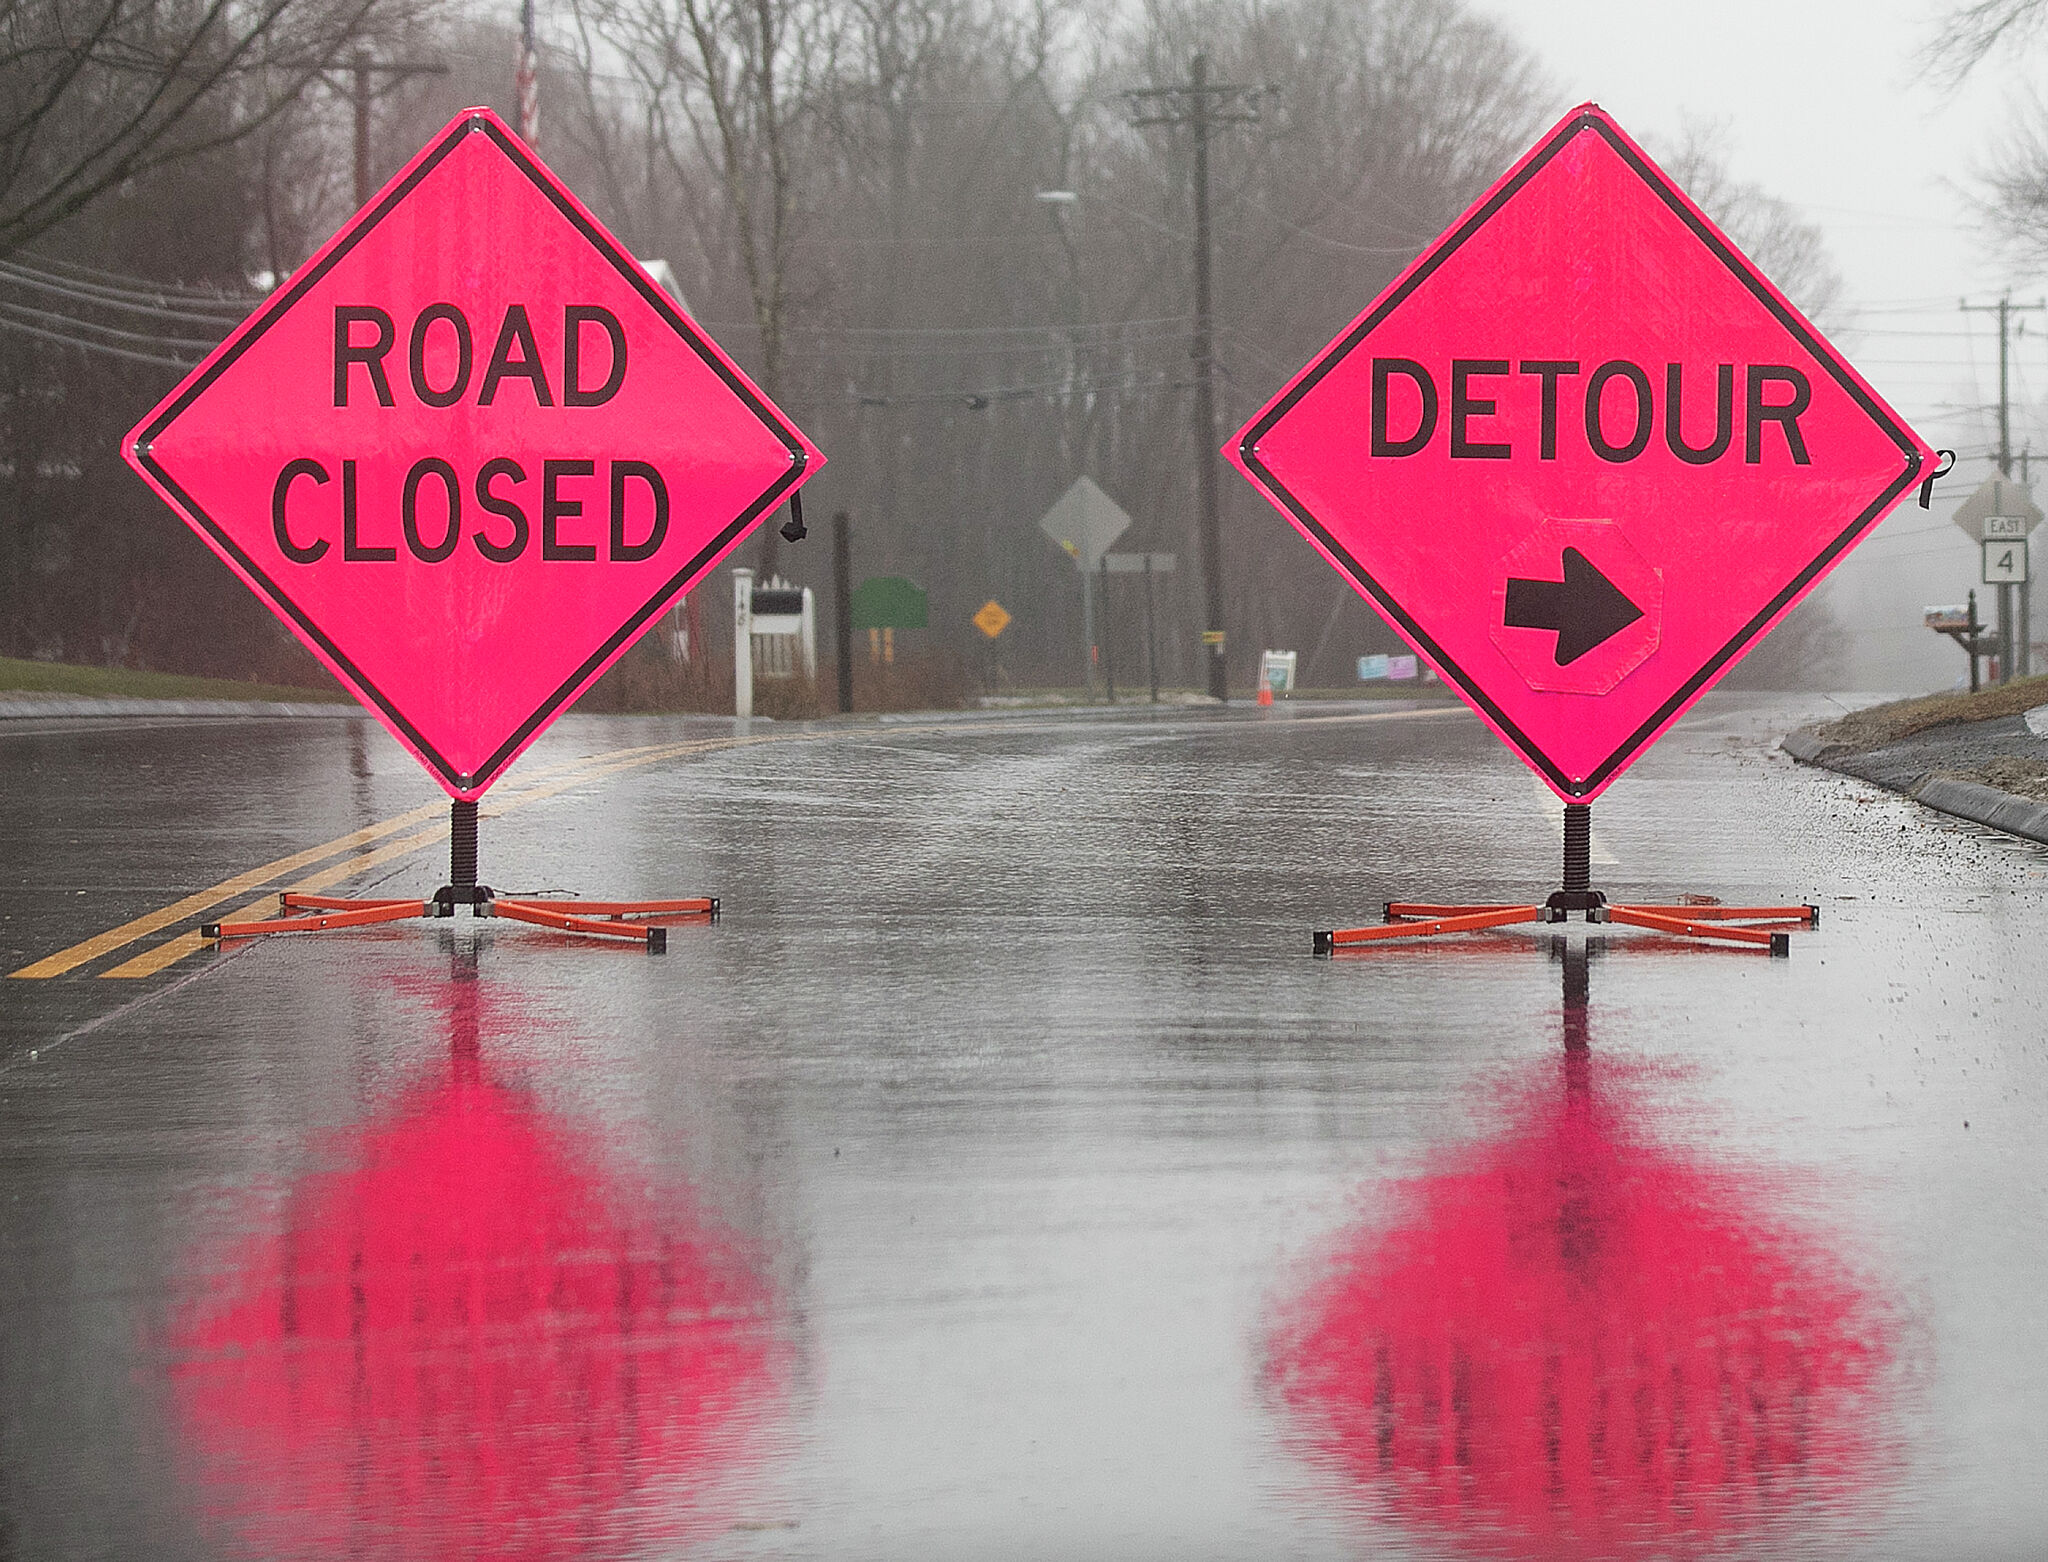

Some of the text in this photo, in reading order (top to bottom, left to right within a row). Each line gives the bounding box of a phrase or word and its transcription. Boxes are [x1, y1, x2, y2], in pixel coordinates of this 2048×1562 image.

[334, 303, 627, 408] ROAD
[1371, 358, 1812, 465] DETOUR
[273, 457, 670, 564] CLOSED
[1990, 519, 2019, 533] EAST
[1997, 549, 2014, 573] 4
